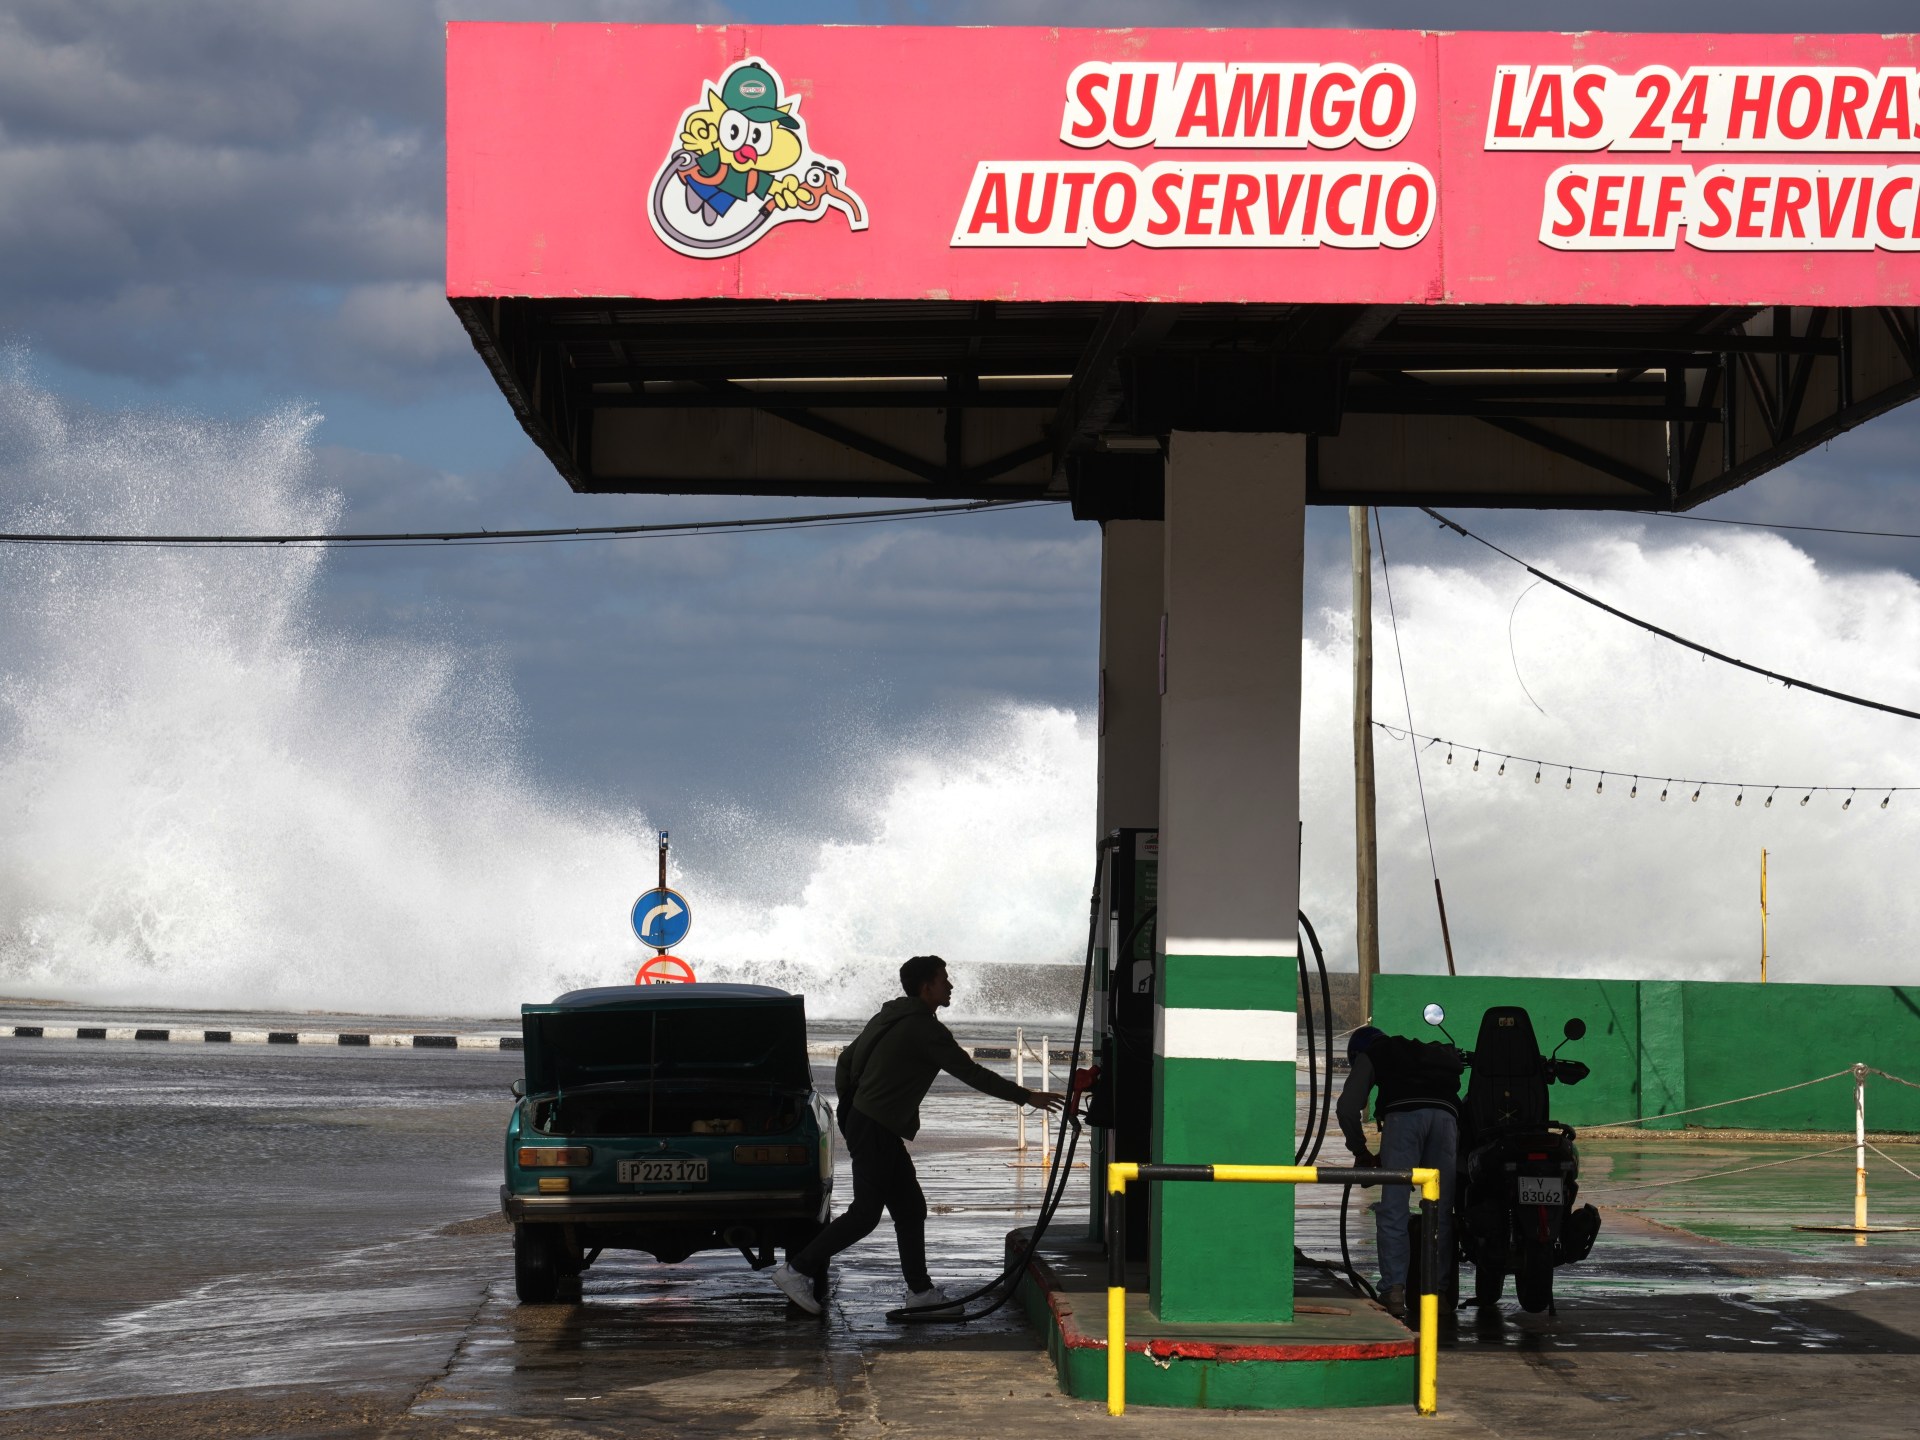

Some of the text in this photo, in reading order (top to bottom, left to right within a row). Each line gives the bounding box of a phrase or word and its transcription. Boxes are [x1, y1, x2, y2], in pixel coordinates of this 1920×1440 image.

[1071, 73, 1405, 138] SU AMIGO
[1494, 74, 1920, 140] LAS 24 HORA
[1552, 175, 1920, 239] SELF SERVIC
[1522, 1191, 1560, 1202] 83062
